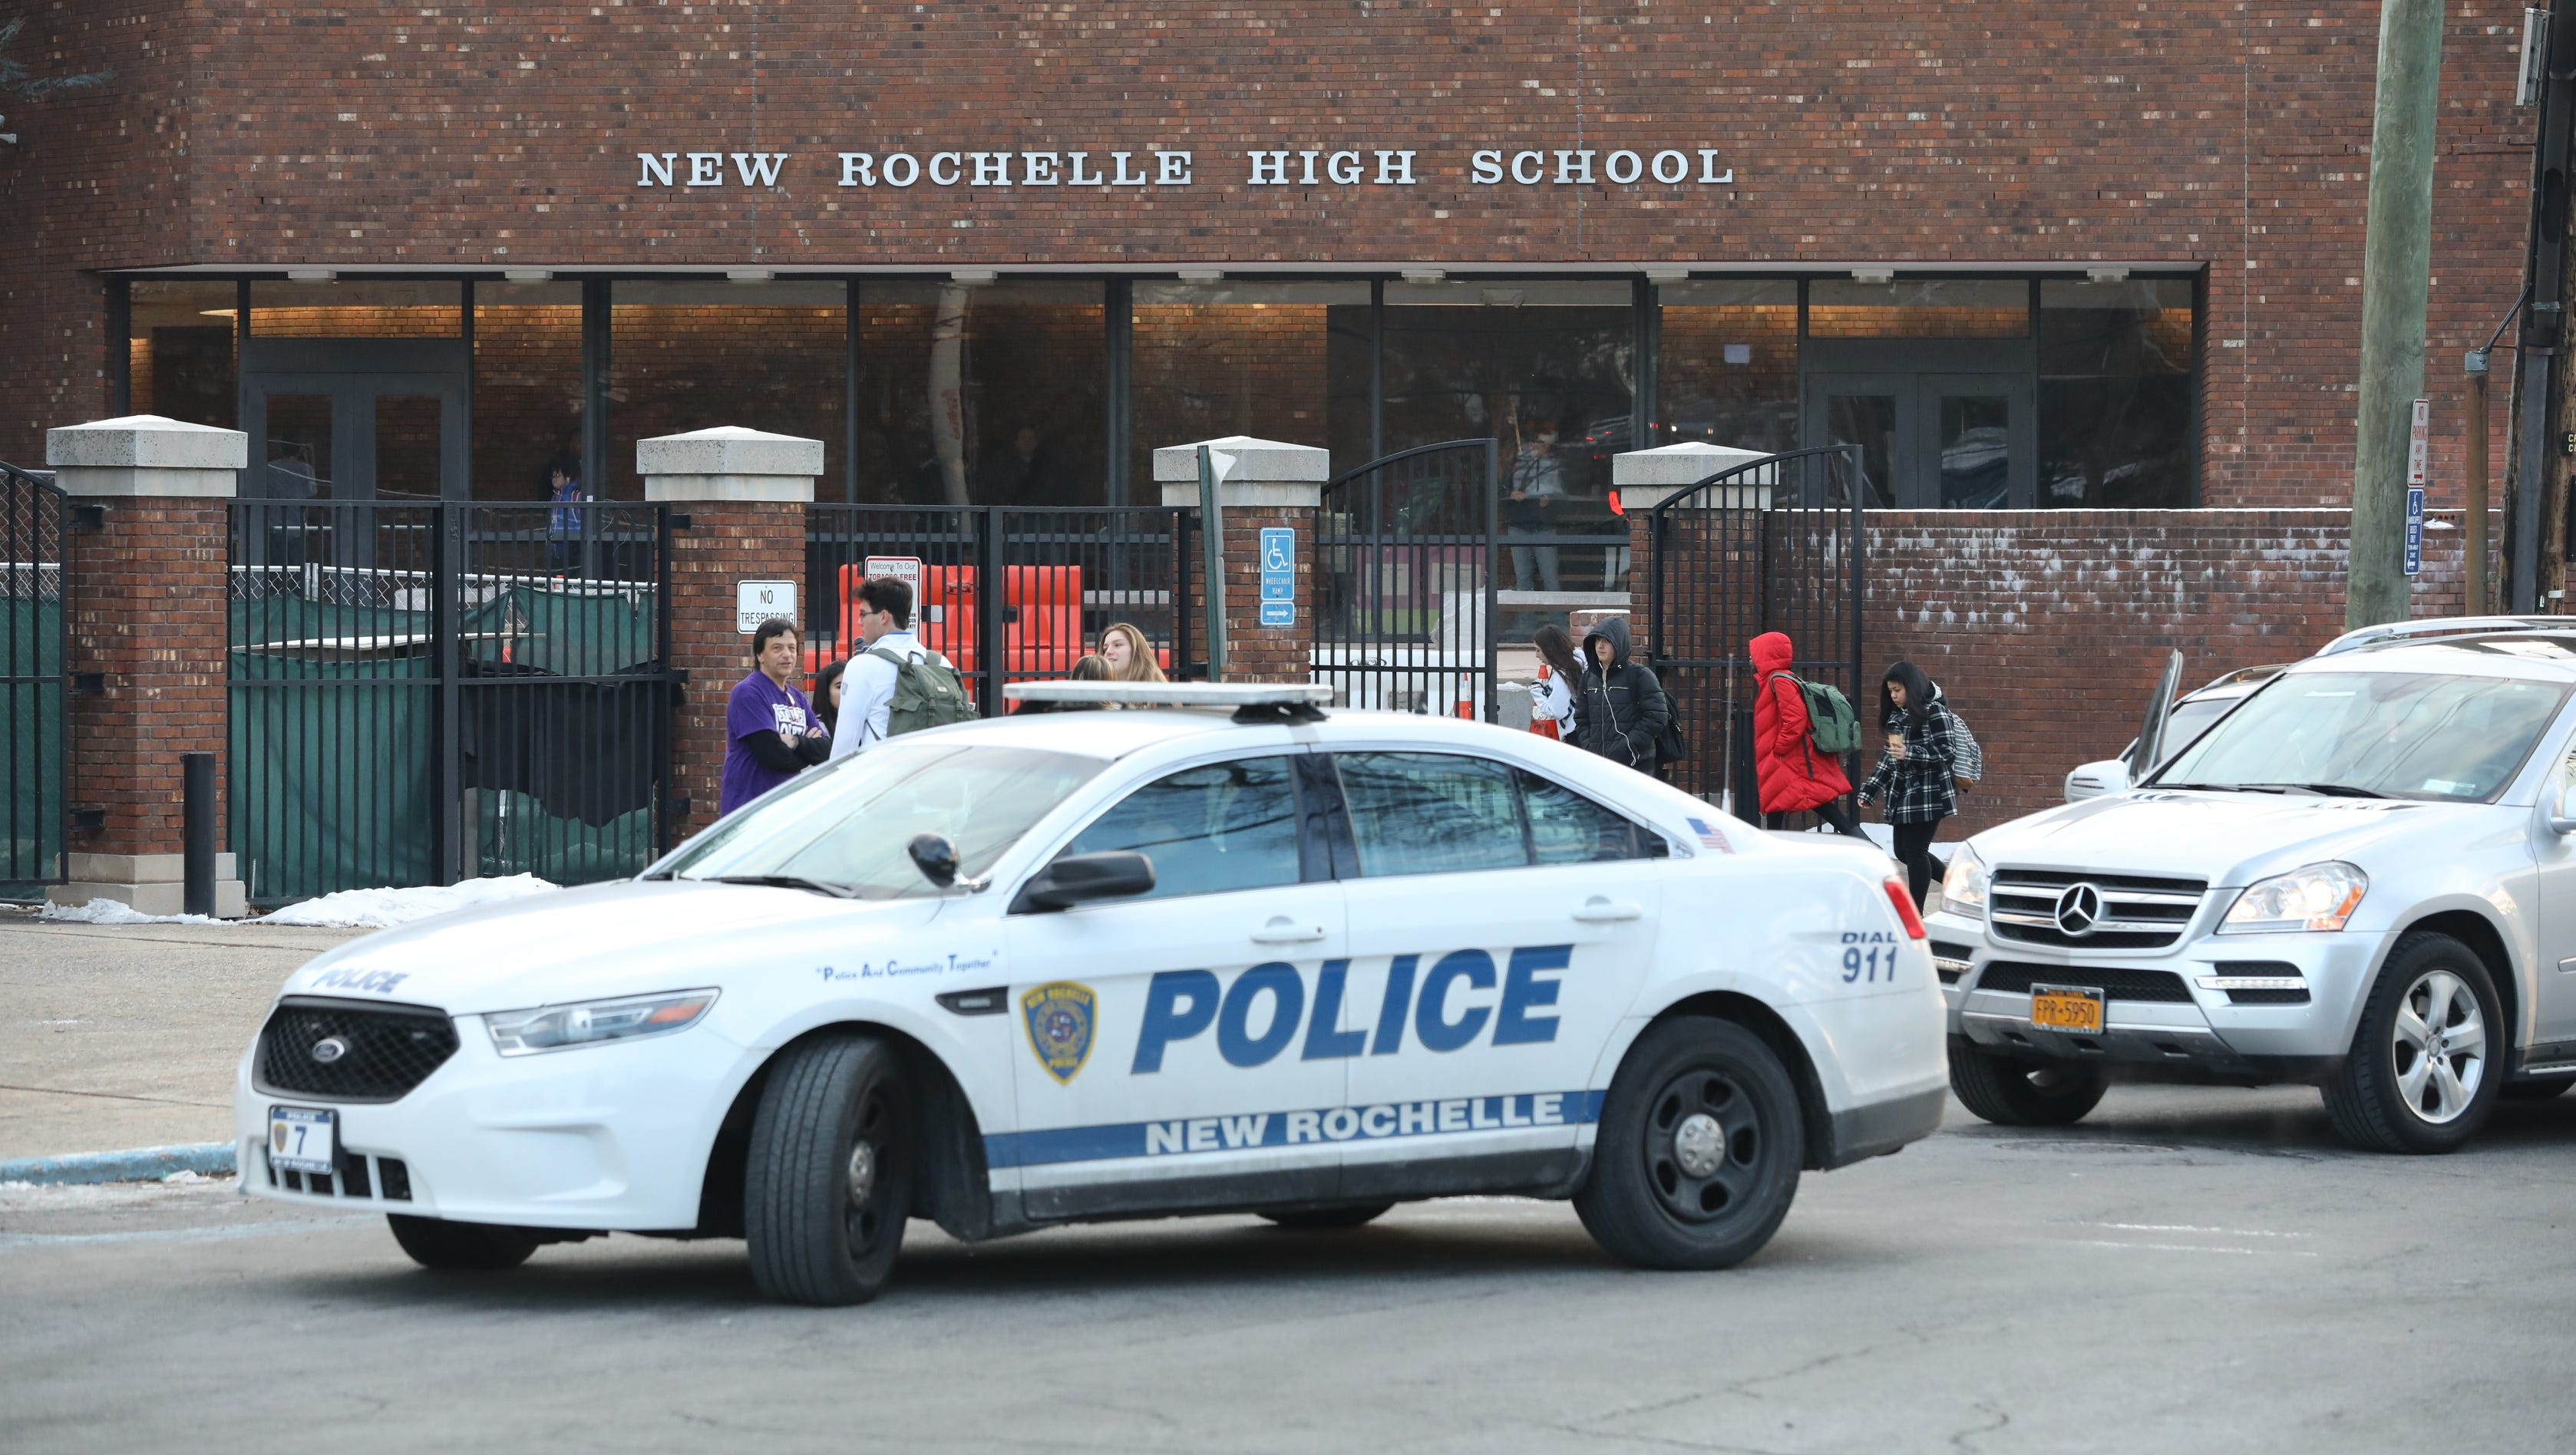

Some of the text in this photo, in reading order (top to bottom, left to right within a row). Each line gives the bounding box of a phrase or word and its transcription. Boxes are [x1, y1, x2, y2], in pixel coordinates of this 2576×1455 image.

[636, 149, 1733, 187] NEW ROCHELLE HIGH SCHOOL
[904, 562, 916, 570] Our
[760, 589, 774, 605] NO
[1841, 932, 1898, 944] DIAL
[1842, 946, 1897, 983] 911
[311, 968, 411, 994] POLICE
[1130, 943, 1575, 1075] POLICE
[1146, 1093, 1564, 1153] NEW ROCHELLE
[295, 1125, 307, 1155] 7
